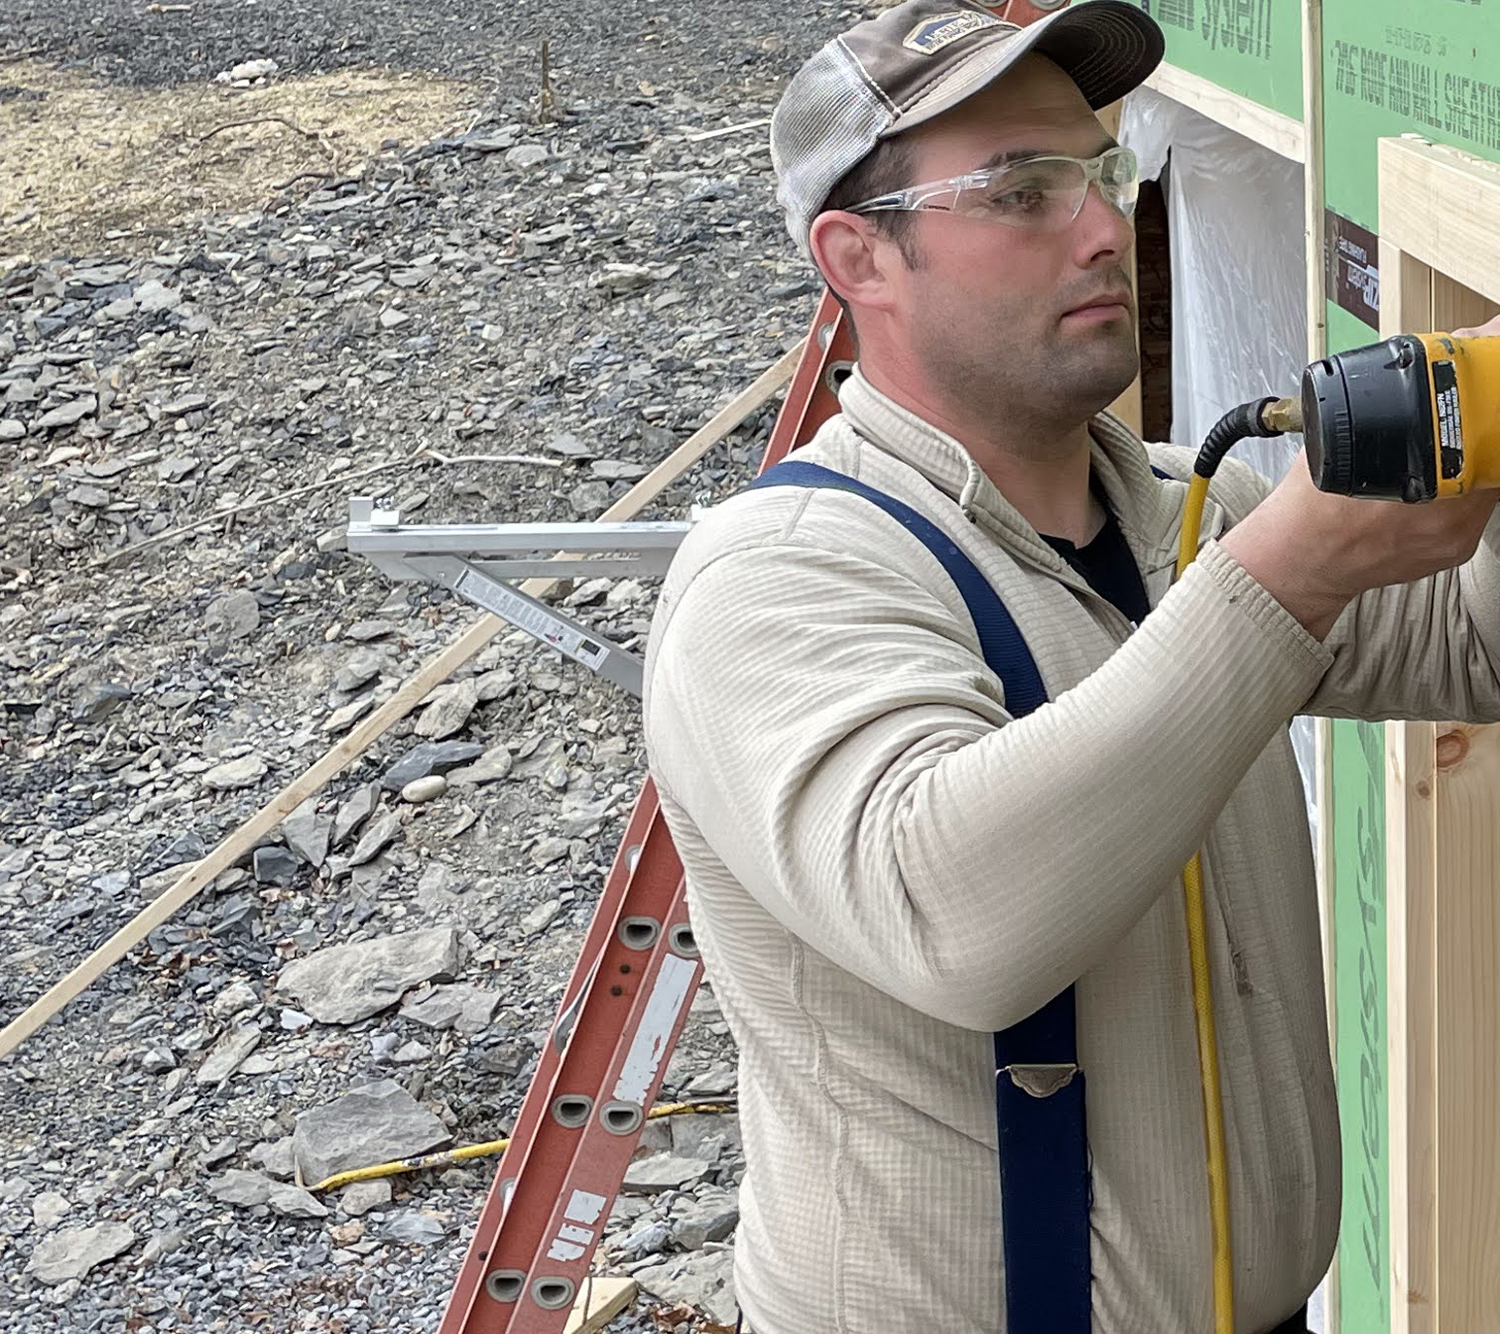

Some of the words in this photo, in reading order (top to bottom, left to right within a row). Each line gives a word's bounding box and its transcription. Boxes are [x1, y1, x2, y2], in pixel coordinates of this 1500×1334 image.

[1360, 47, 1388, 107] ROOF
[1388, 55, 1411, 117] AND
[1411, 62, 1442, 129] WALL
